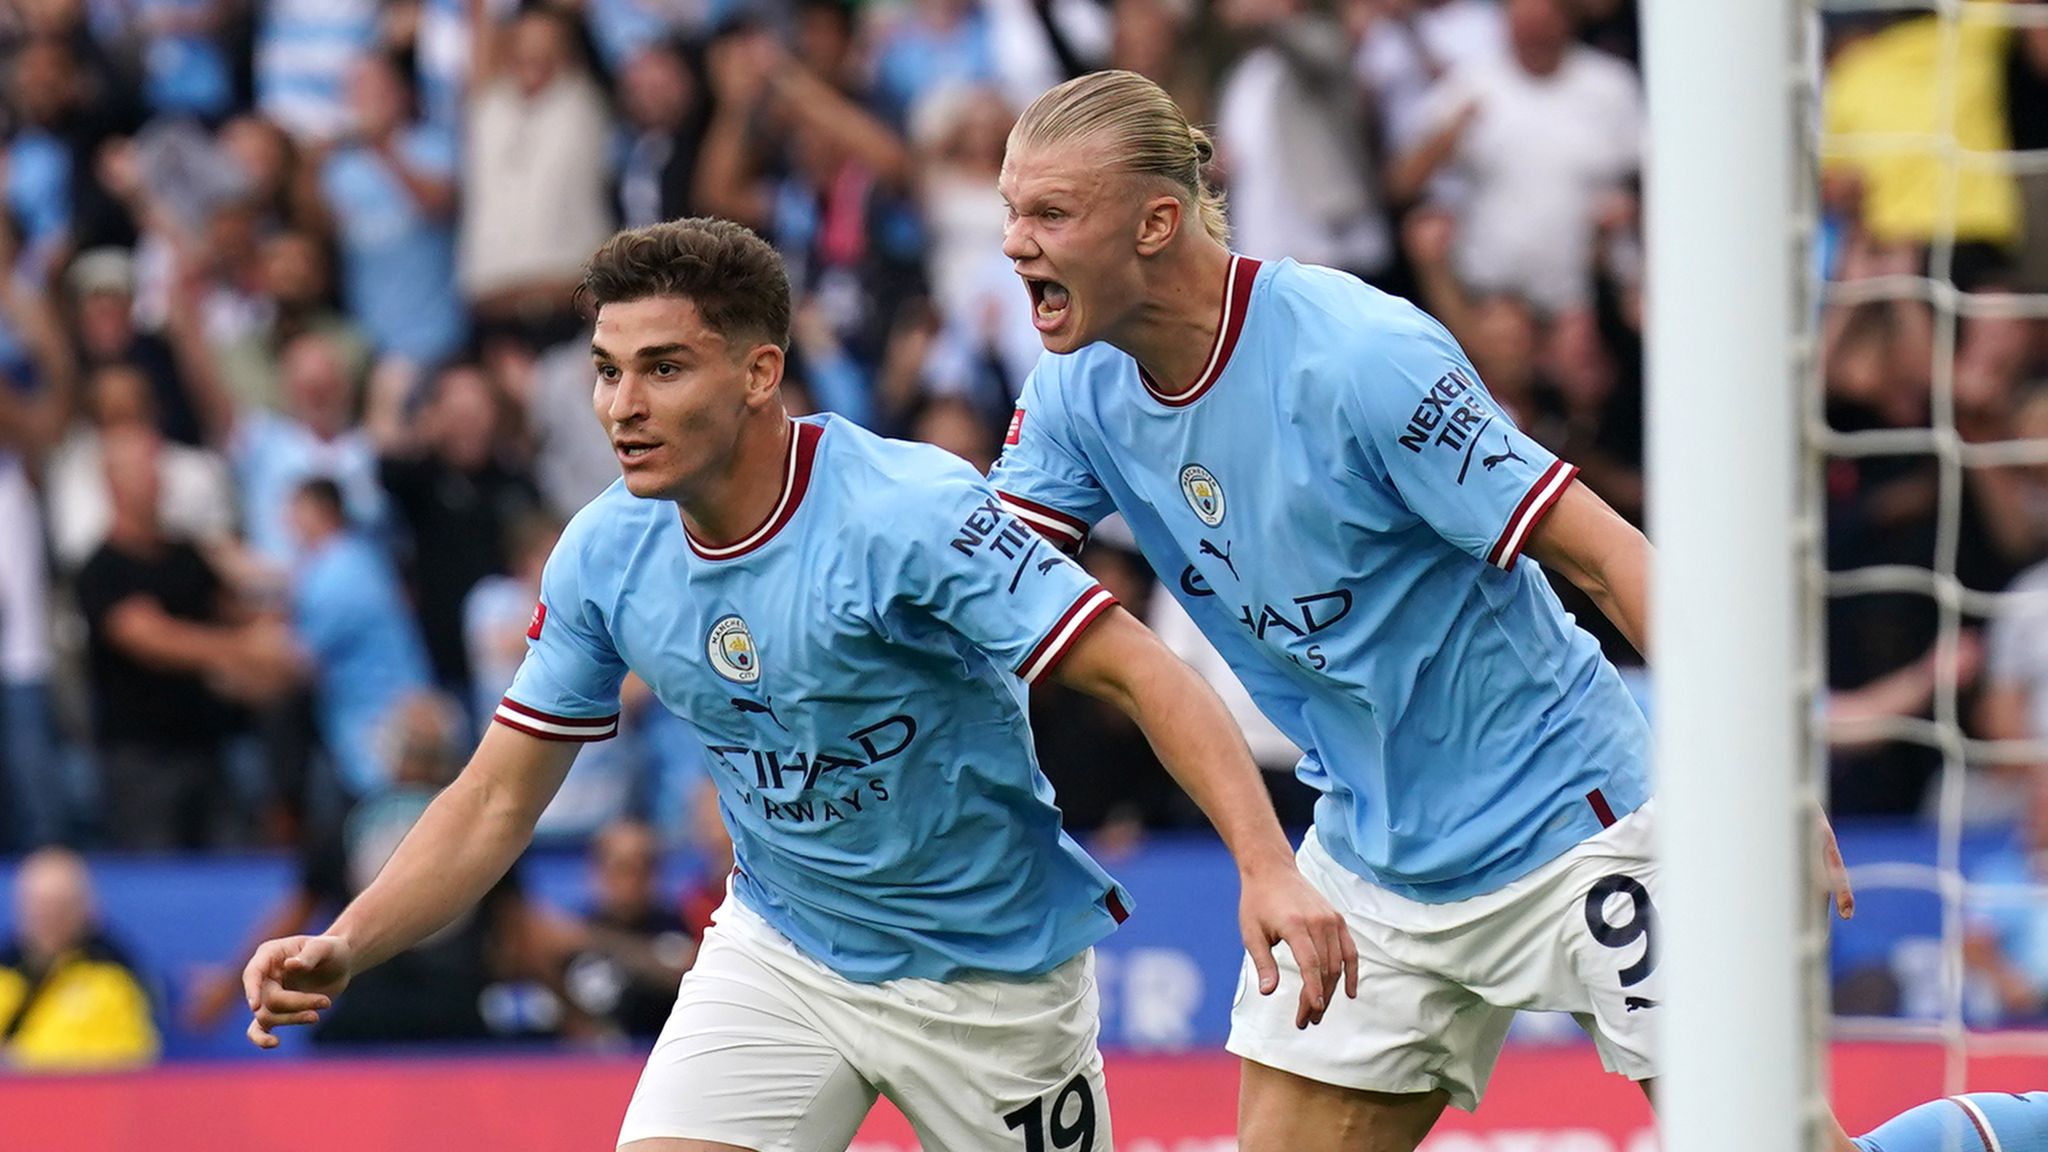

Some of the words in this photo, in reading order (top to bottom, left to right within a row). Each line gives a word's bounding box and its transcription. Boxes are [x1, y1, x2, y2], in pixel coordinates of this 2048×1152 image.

[1398, 366, 1473, 454] NEXEN
[1434, 395, 1487, 452] TIRE
[1584, 873, 1664, 988] 9
[1002, 1073, 1096, 1152] 19
